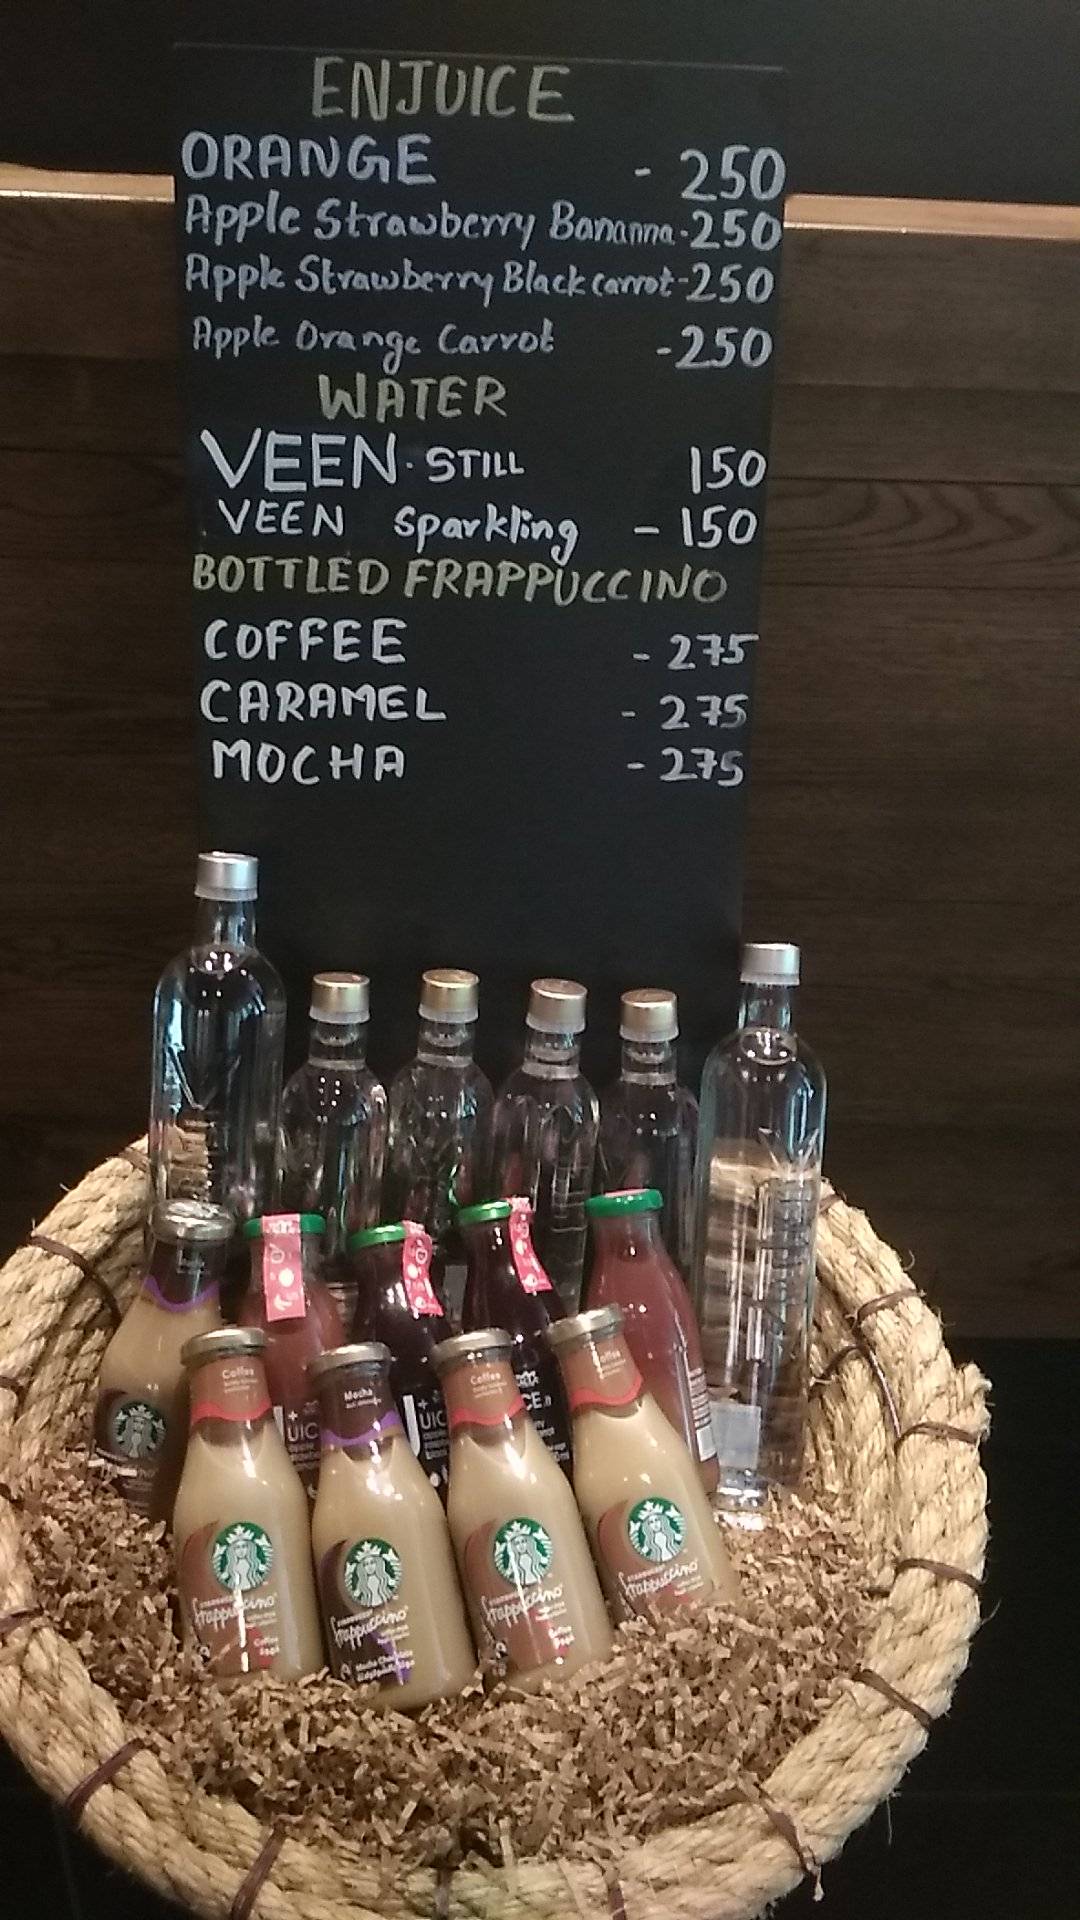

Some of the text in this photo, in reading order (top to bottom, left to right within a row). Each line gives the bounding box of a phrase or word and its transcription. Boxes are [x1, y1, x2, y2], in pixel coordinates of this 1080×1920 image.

[312, 56, 575, 122] ENJUICE
[181, 131, 436, 184] ORANGE
[680, 145, 786, 201] 250
[185, 188, 301, 247] Apple
[313, 197, 536, 252] Strawberry
[185, 252, 286, 303] Apple
[294, 254, 494, 309] Strawberry
[502, 259, 586, 297] Black
[193, 314, 280, 360] Apple
[295, 319, 422, 374] Orange
[438, 317, 554, 354] Carrot
[318, 369, 507, 423] WATER
[425, 446, 525, 483] STILL
[690, 446, 767, 495] 150
[218, 498, 344, 537] VEEN
[681, 504, 758, 549] 150
[192, 553, 727, 606] BOTTLED FRAPPUCCINO
[204, 617, 408, 664] COFFEE
[667, 633, 760, 670] 275
[200, 679, 447, 724] CARAMEL
[659, 693, 749, 730] 275
[212, 739, 405, 785] MOCHA
[659, 746, 744, 787] 275
